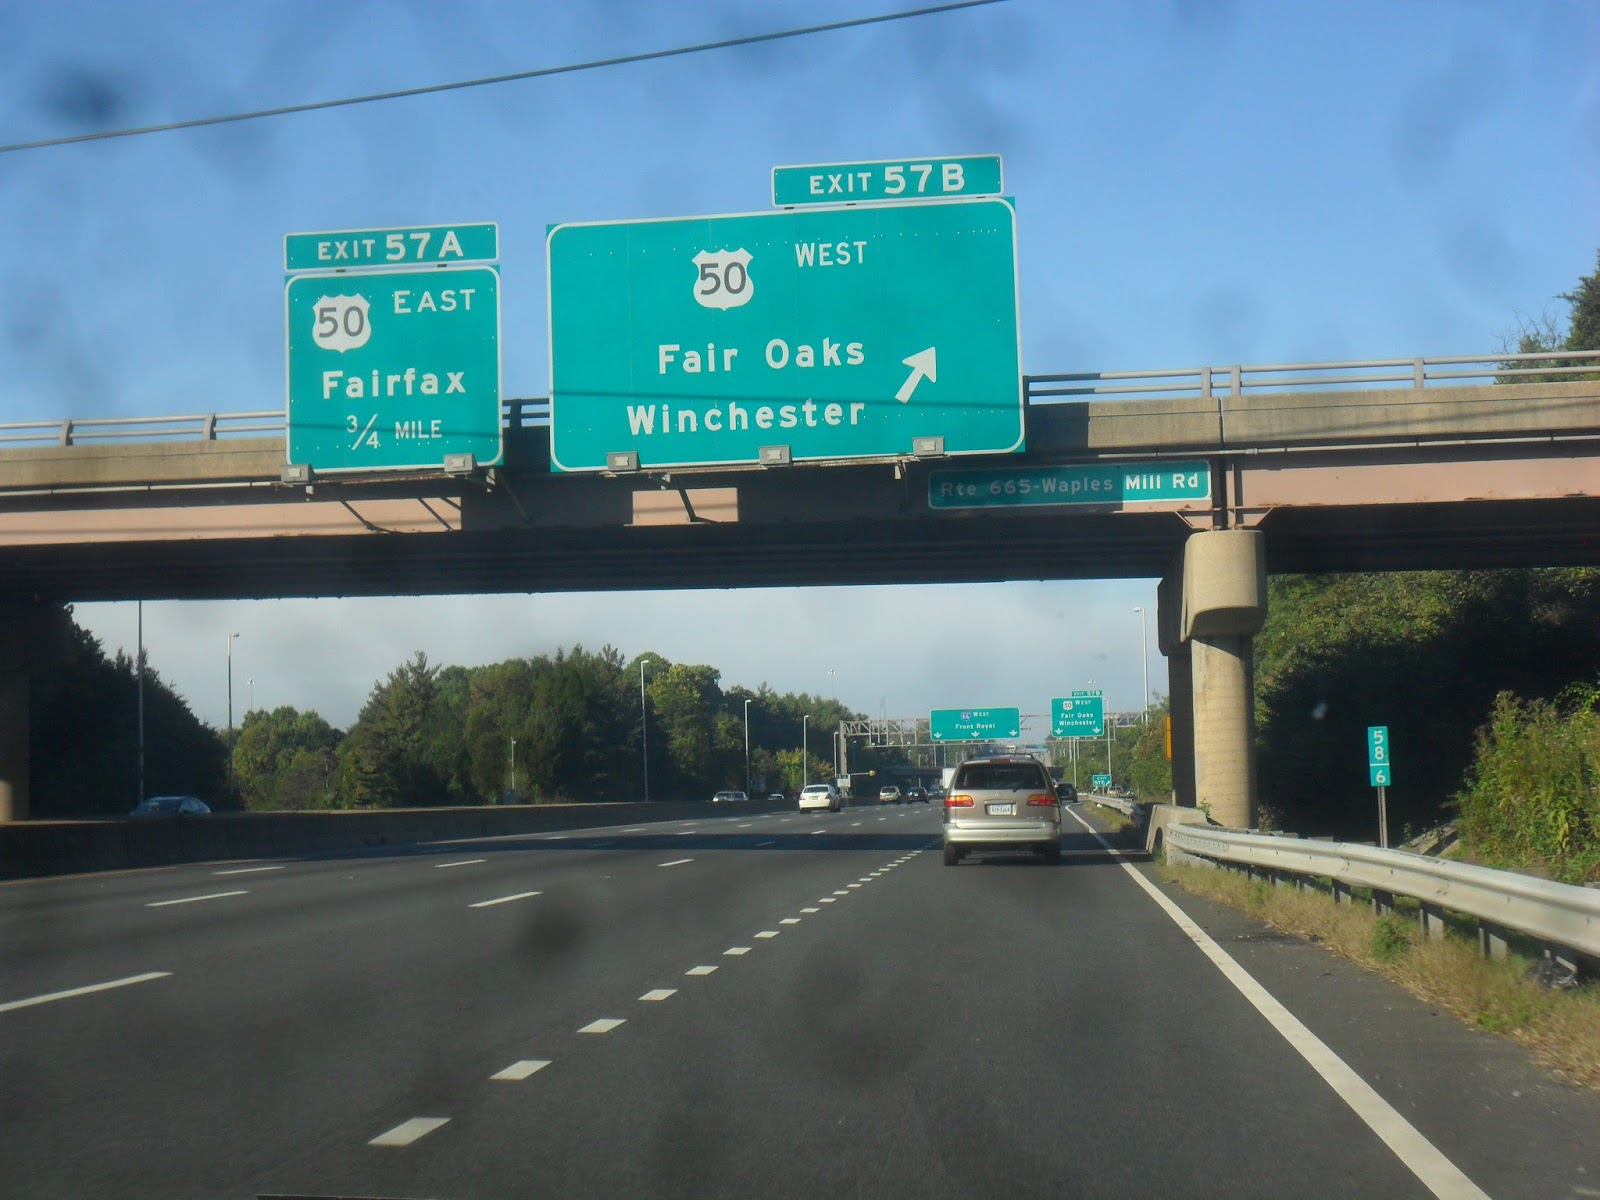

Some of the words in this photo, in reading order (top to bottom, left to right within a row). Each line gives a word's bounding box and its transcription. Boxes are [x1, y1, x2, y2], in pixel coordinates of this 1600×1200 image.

[808, 172, 872, 195] EXIT
[317, 239, 376, 261] EXIT
[795, 241, 868, 268] WEST
[699, 261, 748, 296] 50
[393, 288, 476, 314] EAST
[318, 306, 364, 338] 50
[658, 343, 739, 375] Fair
[765, 337, 865, 370] Oaks
[323, 368, 466, 400] Fairfax
[395, 420, 442, 440] MILE
[627, 398, 866, 436] Winchester
[941, 482, 977, 497] Rte
[1125, 474, 1161, 490] Mill
[1172, 473, 1199, 488] Rd
